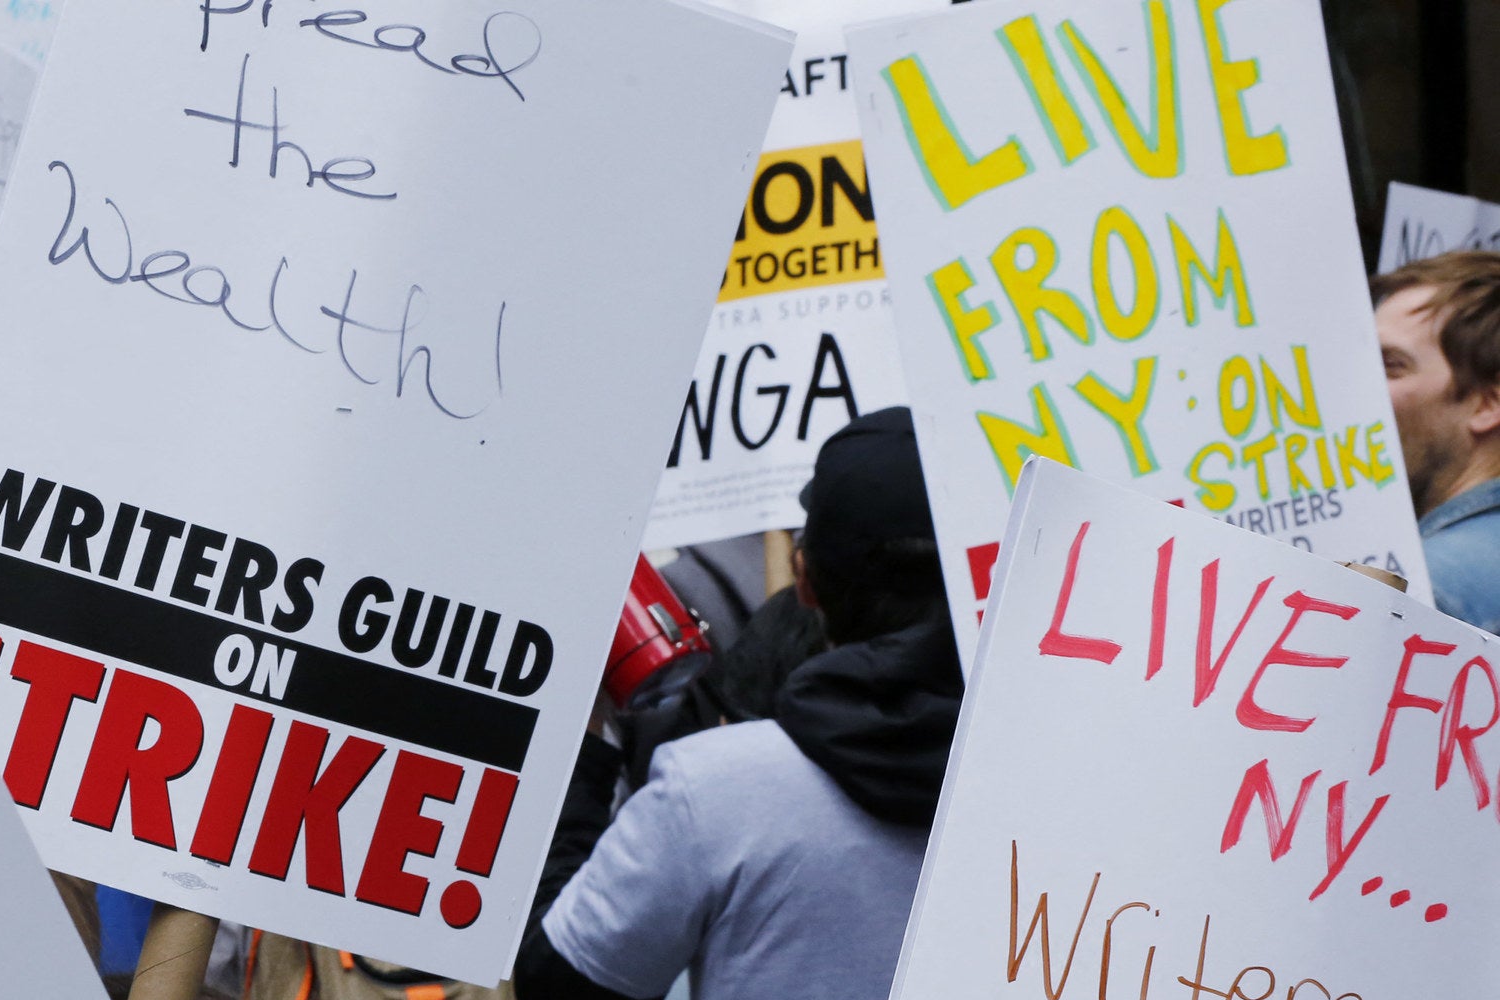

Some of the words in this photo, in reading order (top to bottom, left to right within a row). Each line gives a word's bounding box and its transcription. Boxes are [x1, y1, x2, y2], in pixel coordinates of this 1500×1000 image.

[185, 54, 397, 200] the
[880, 0, 1291, 211] LIVE
[735, 238, 880, 288] TOGETH
[925, 205, 1258, 384] FROM
[1218, 345, 1324, 441] ON
[1184, 420, 1396, 512] STRIKE
[213, 633, 298, 700] ON
[338, 576, 554, 697] GUILD
[1039, 521, 1361, 733] LIVE
[1369, 634, 1500, 828] FR
